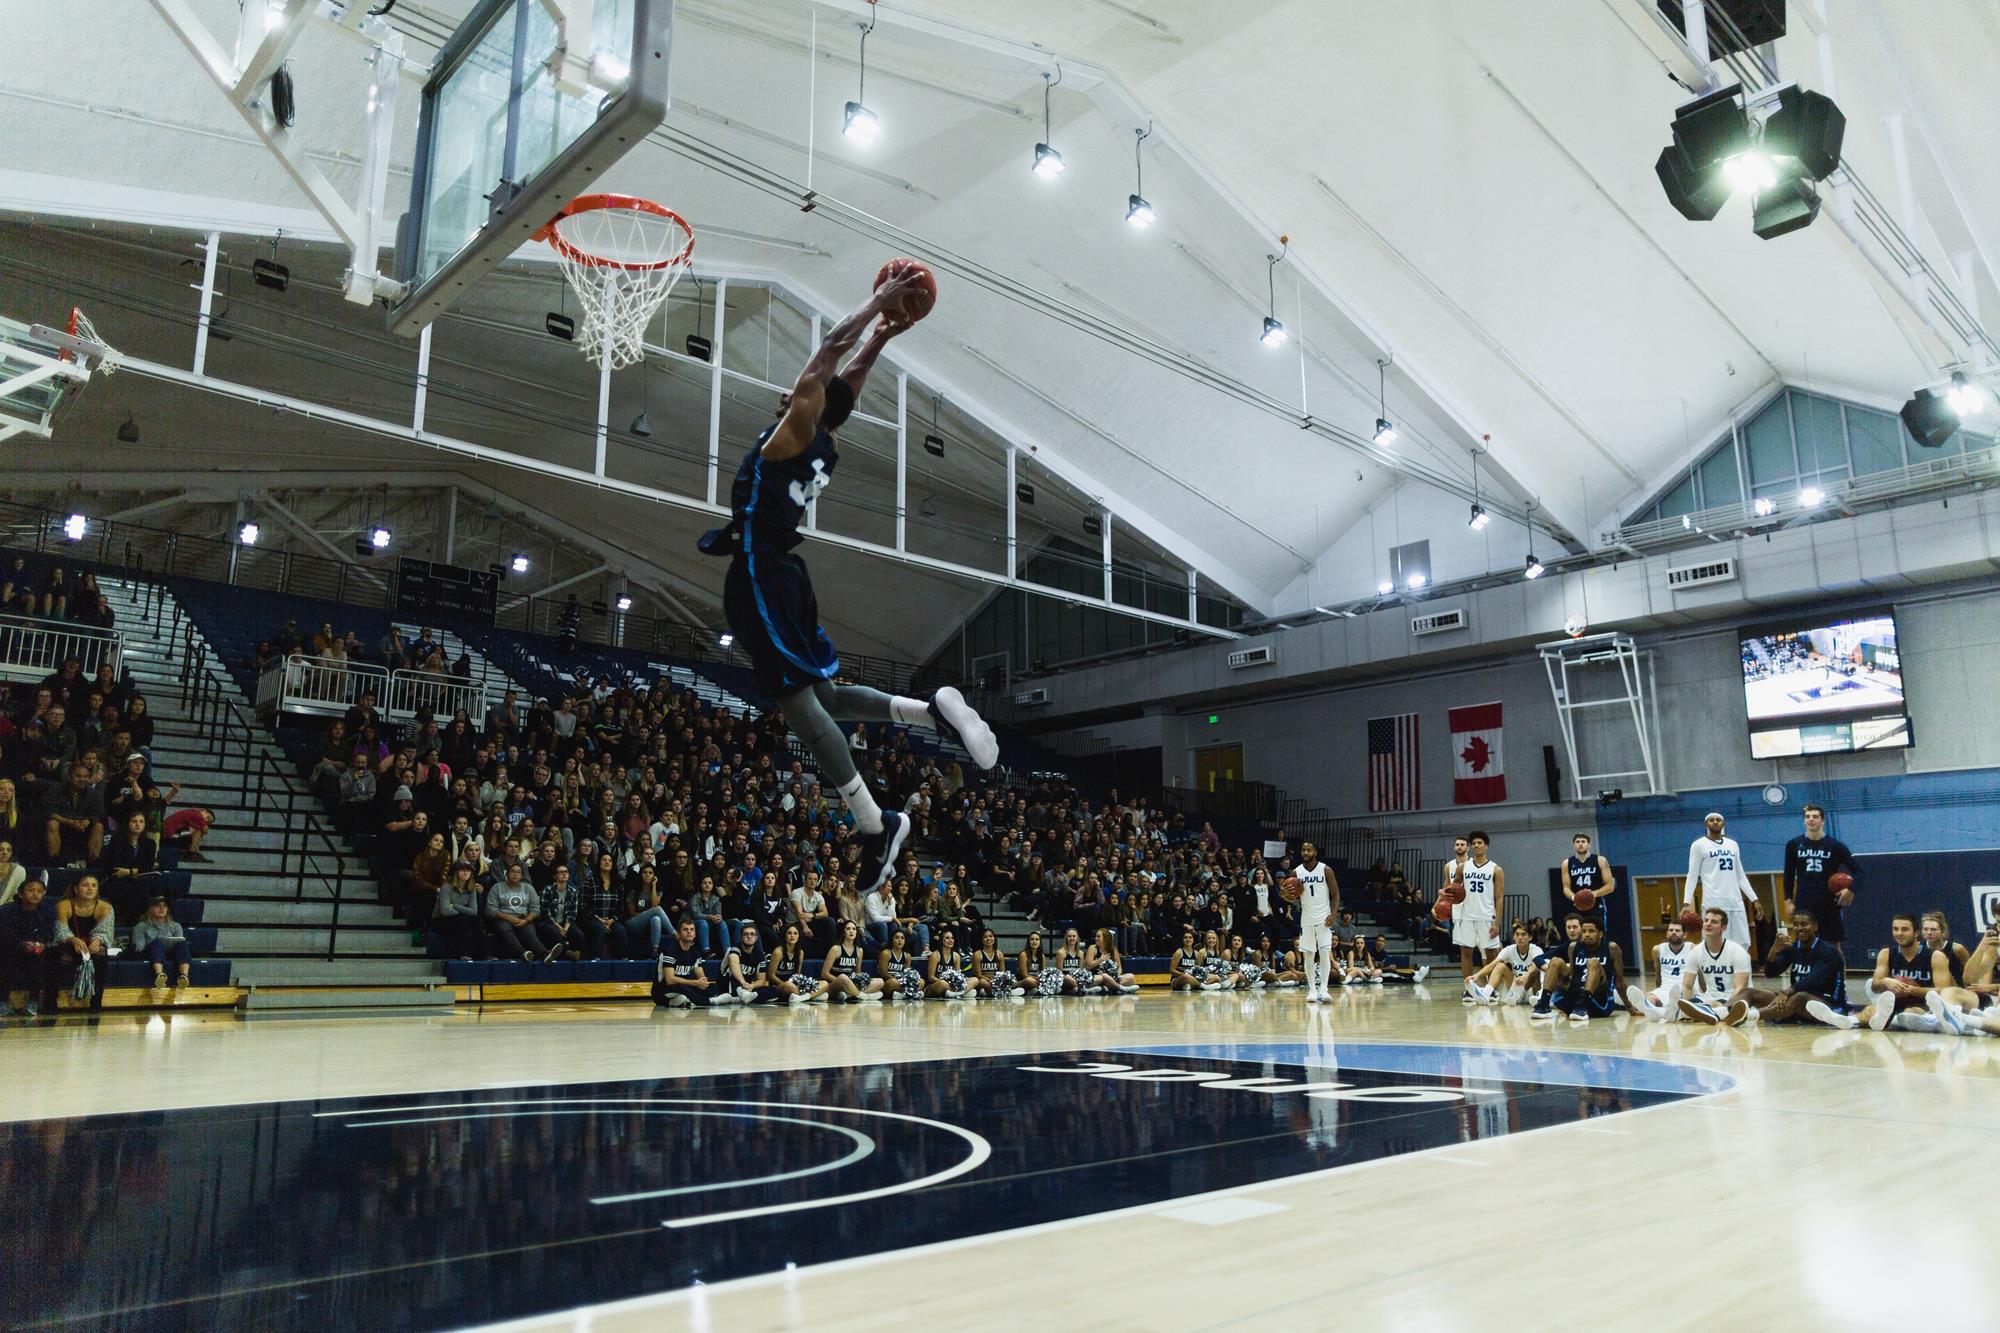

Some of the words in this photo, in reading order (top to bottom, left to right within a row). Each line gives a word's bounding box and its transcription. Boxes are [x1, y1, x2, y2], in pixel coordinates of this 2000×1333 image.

[1709, 850, 1735, 858] WWU
[1797, 849, 1831, 858] WWU
[1719, 858, 1733, 871] 23
[1806, 858, 1823, 872] 25
[1464, 872, 1491, 880] WWU
[1570, 867, 1596, 876] WWU
[1576, 874, 1592, 886] 44
[1309, 885, 1314, 897] 1
[1470, 881, 1484, 893] 35
[1671, 967, 1681, 976] 4
[1701, 965, 1734, 975] WWU
[1891, 968, 1931, 980] WWU
[1714, 976, 1726, 992] 5
